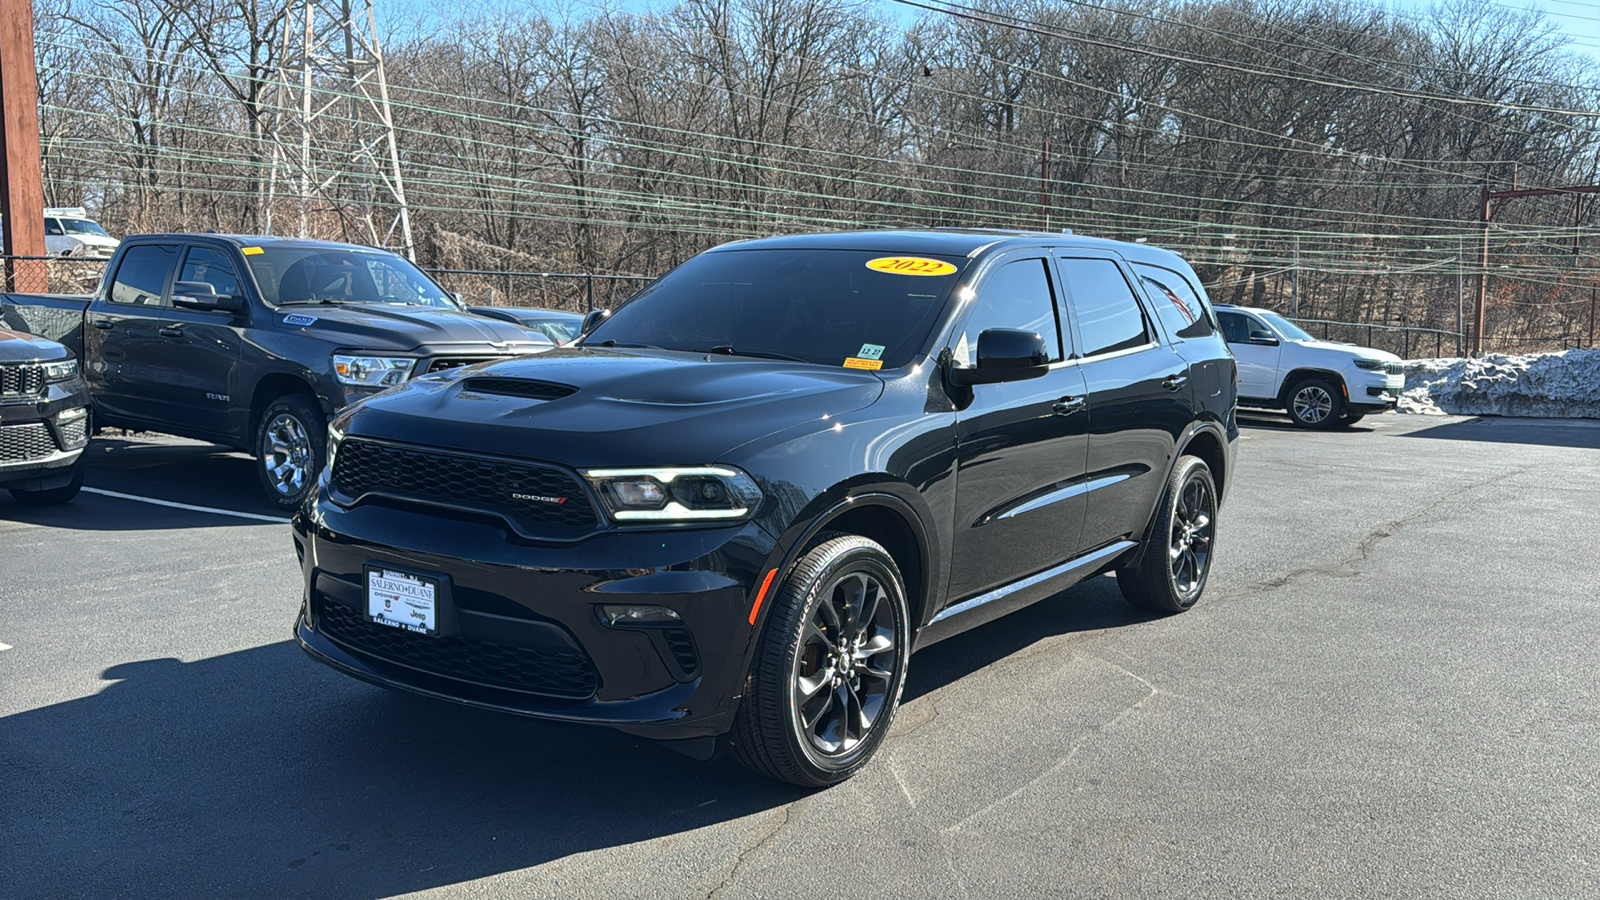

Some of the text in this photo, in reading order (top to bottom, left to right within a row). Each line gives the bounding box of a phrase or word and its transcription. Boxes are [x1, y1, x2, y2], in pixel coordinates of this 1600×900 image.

[879, 259, 944, 273] 2022
[861, 347, 871, 355] 12
[206, 392, 230, 402] RAM
[512, 493, 560, 503] DODGE
[371, 578, 434, 599] SALERNO DUANE
[410, 609, 427, 621] Jeep
[373, 617, 400, 628] SALERNO
